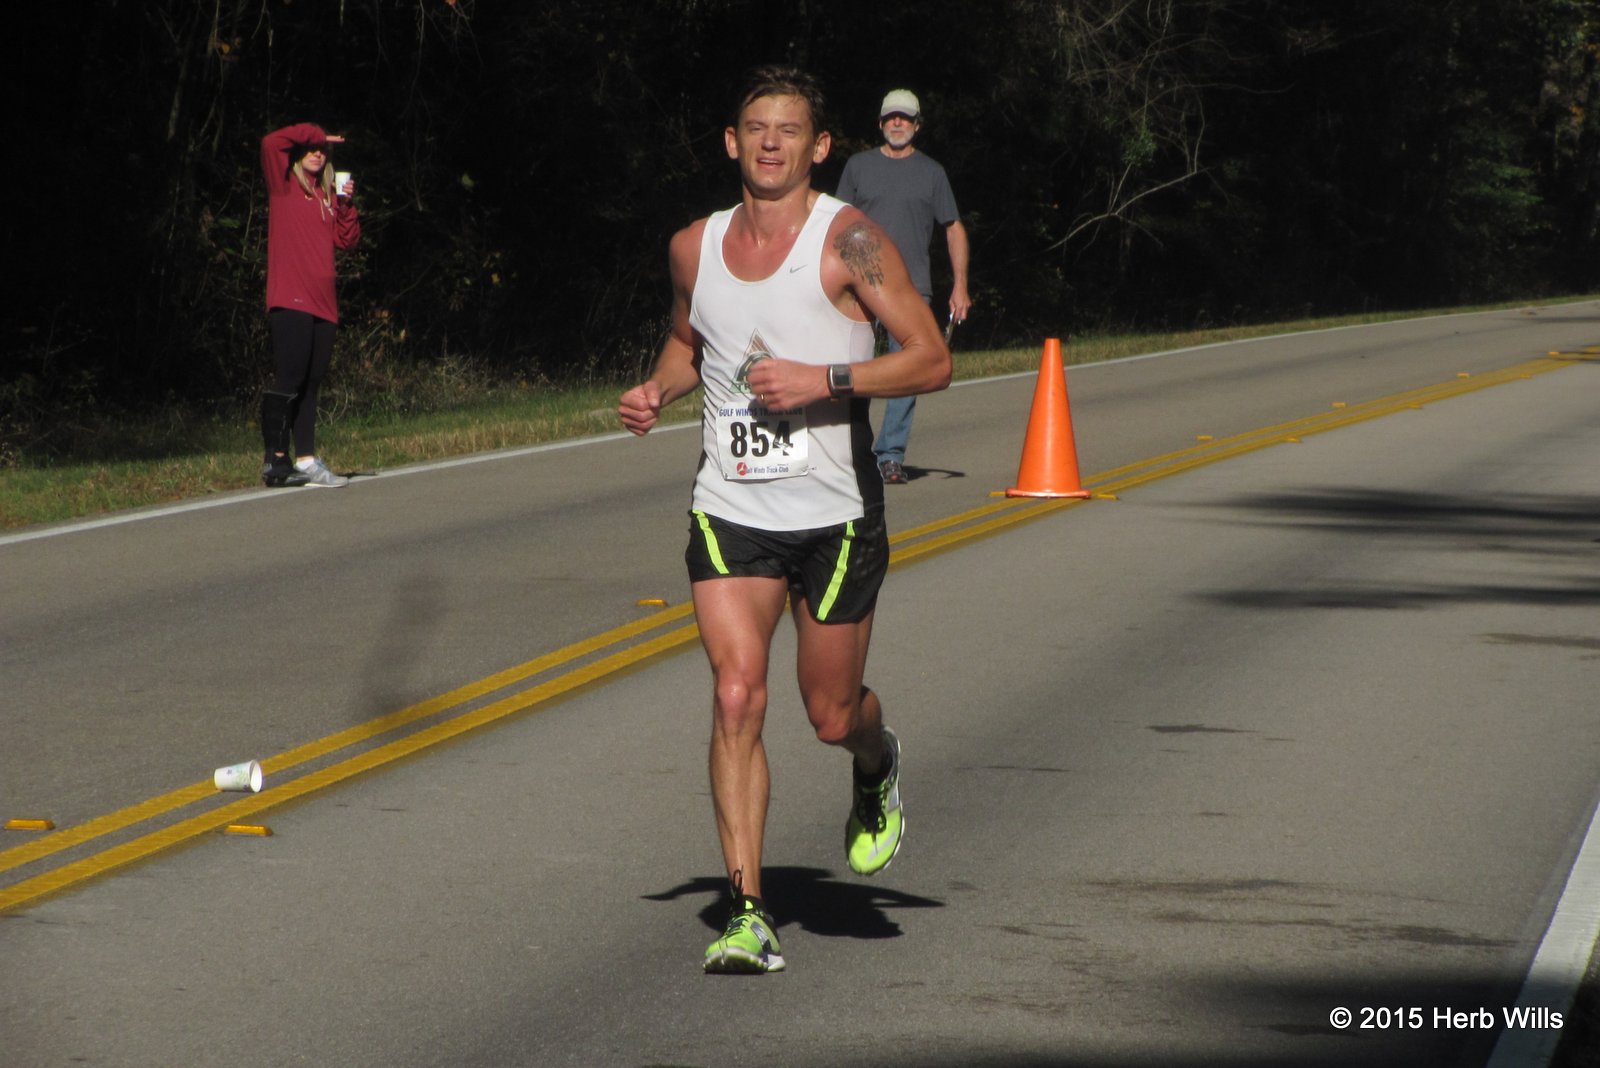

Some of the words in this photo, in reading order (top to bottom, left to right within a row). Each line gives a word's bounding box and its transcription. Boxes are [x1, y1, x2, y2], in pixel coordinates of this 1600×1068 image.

[719, 408, 734, 417] GULF
[735, 408, 758, 417] WINDS
[730, 421, 794, 458] 854
[778, 465, 789, 473] Club
